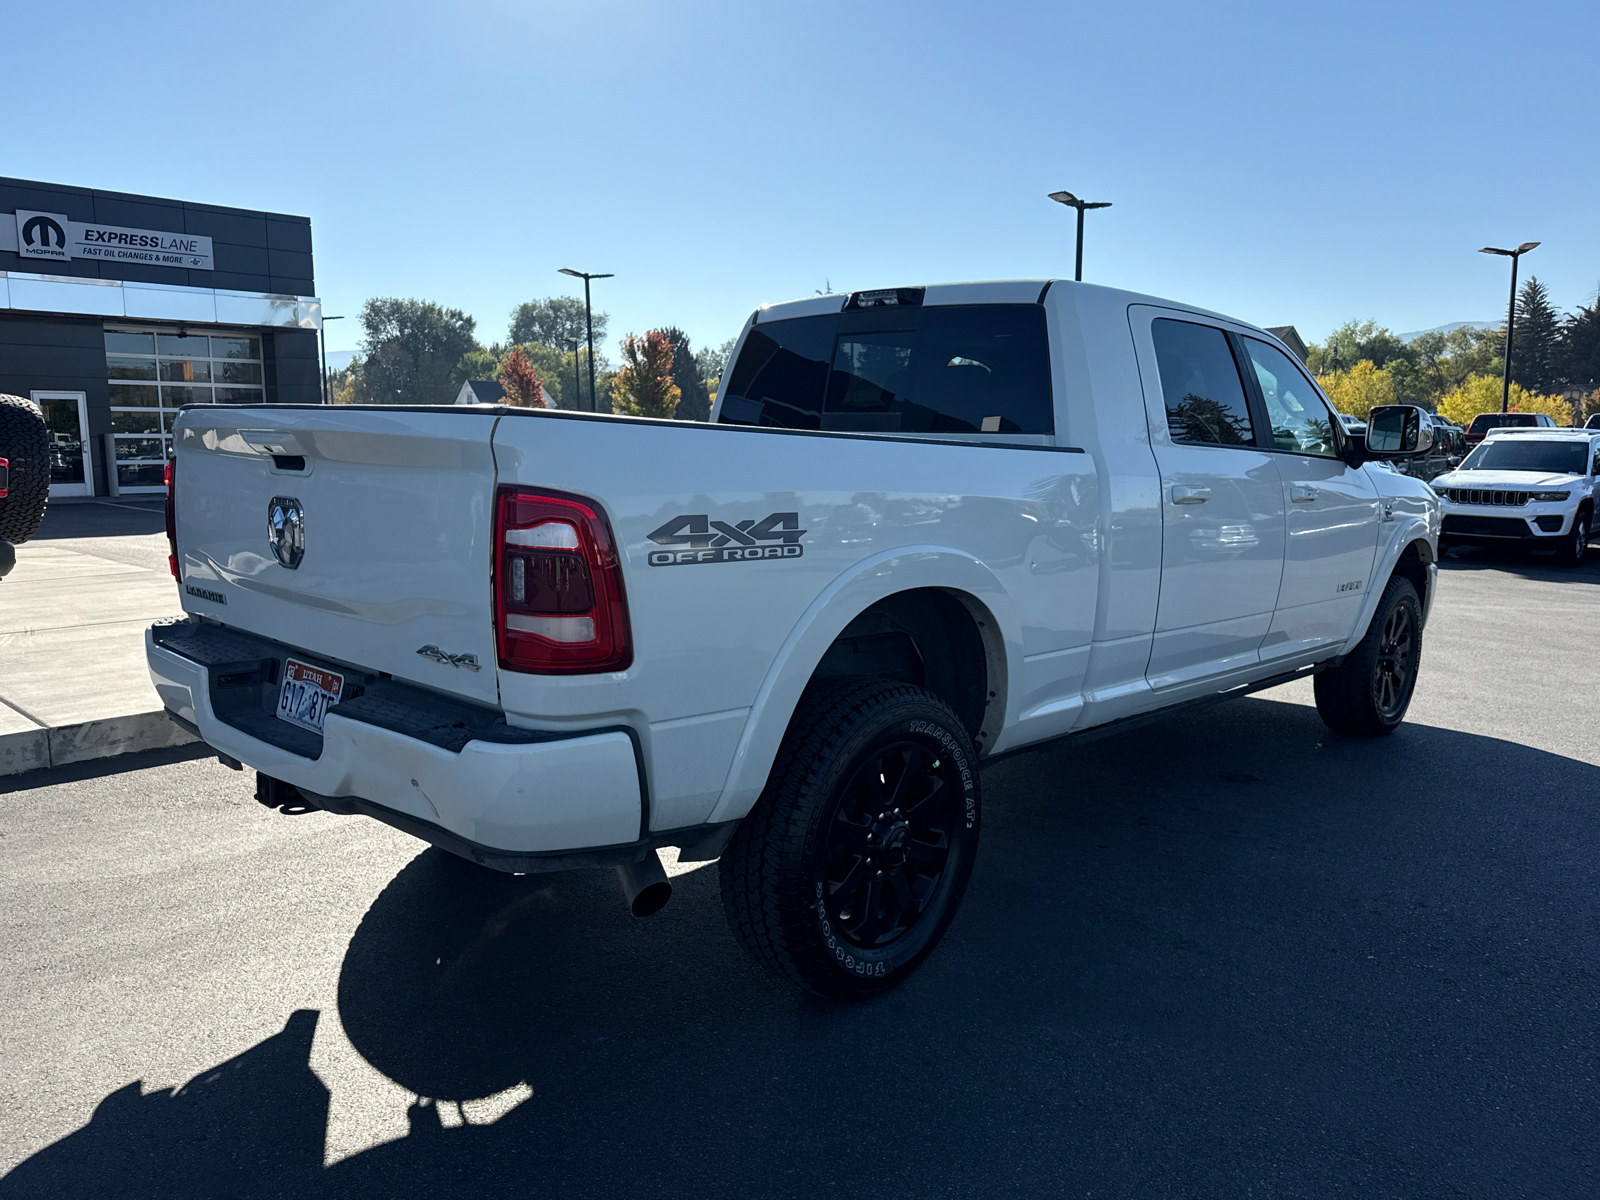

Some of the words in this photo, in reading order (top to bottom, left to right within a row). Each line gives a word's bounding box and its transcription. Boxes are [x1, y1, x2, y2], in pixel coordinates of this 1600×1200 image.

[26, 248, 65, 257] MOPAR
[82, 247, 102, 256] FAST
[103, 249, 116, 258] OIL
[117, 250, 153, 261] CHANGES
[162, 256, 183, 264] MORE
[651, 550, 716, 564] OFF
[722, 547, 801, 560] ROAD
[302, 669, 323, 684] UTAH
[281, 680, 305, 714] G17
[909, 720, 973, 791] TRANSFORCE
